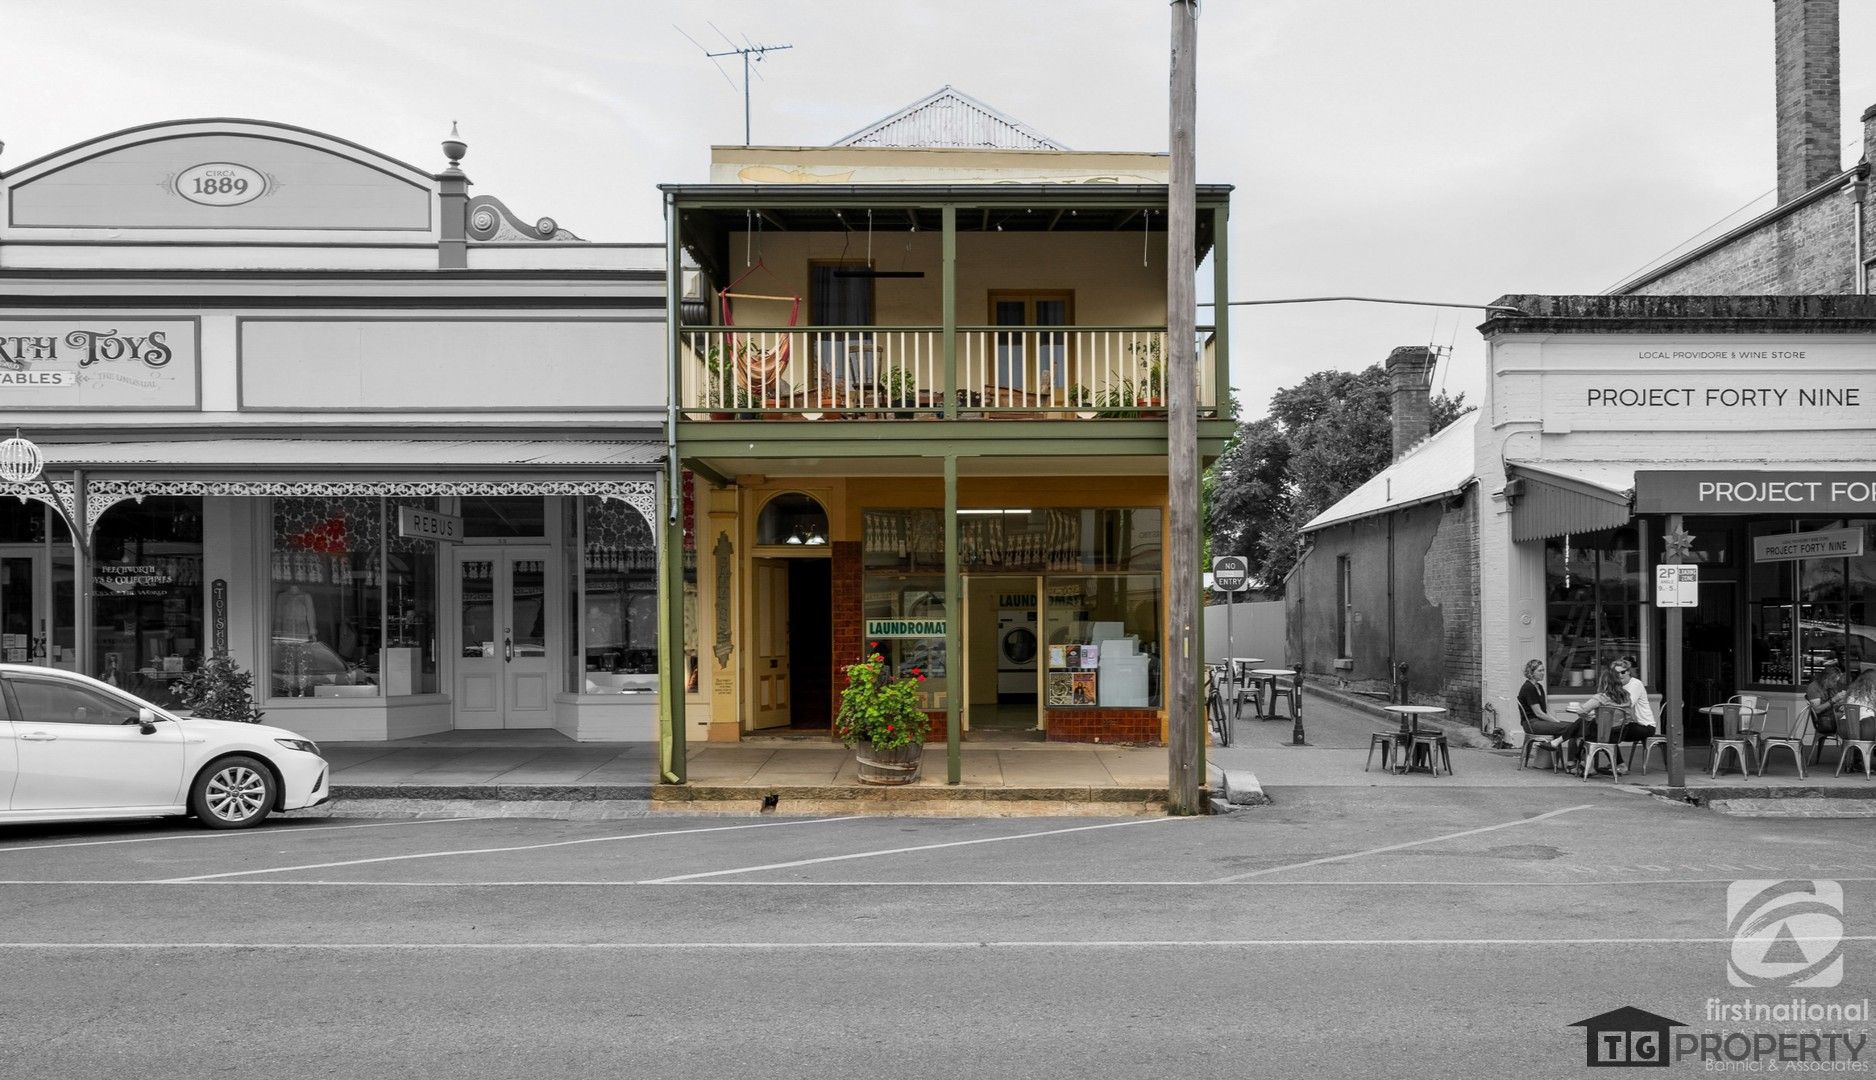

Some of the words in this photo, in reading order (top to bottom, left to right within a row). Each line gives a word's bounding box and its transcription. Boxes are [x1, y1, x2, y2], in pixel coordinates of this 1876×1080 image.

[193, 177, 248, 196] 1889
[1638, 351, 1670, 359] LOCAL
[1672, 351, 1728, 359] PROVIDORE
[1731, 351, 1736, 359] &
[1739, 351, 1768, 359] WINE
[1771, 351, 1806, 359] STORE
[1587, 388, 1695, 407] PROJECT
[1706, 388, 1788, 407] FORTY
[1799, 388, 1860, 407] NINE
[1699, 482, 1822, 502] PROJECT
[414, 515, 453, 536] REBUS
[1766, 545, 1798, 556] PROJECT
[1800, 543, 1825, 553] FORTY
[1829, 540, 1847, 551] NINE
[1225, 562, 1236, 570] NO
[1659, 568, 1675, 578] 2P
[1219, 578, 1242, 586] ENTRY
